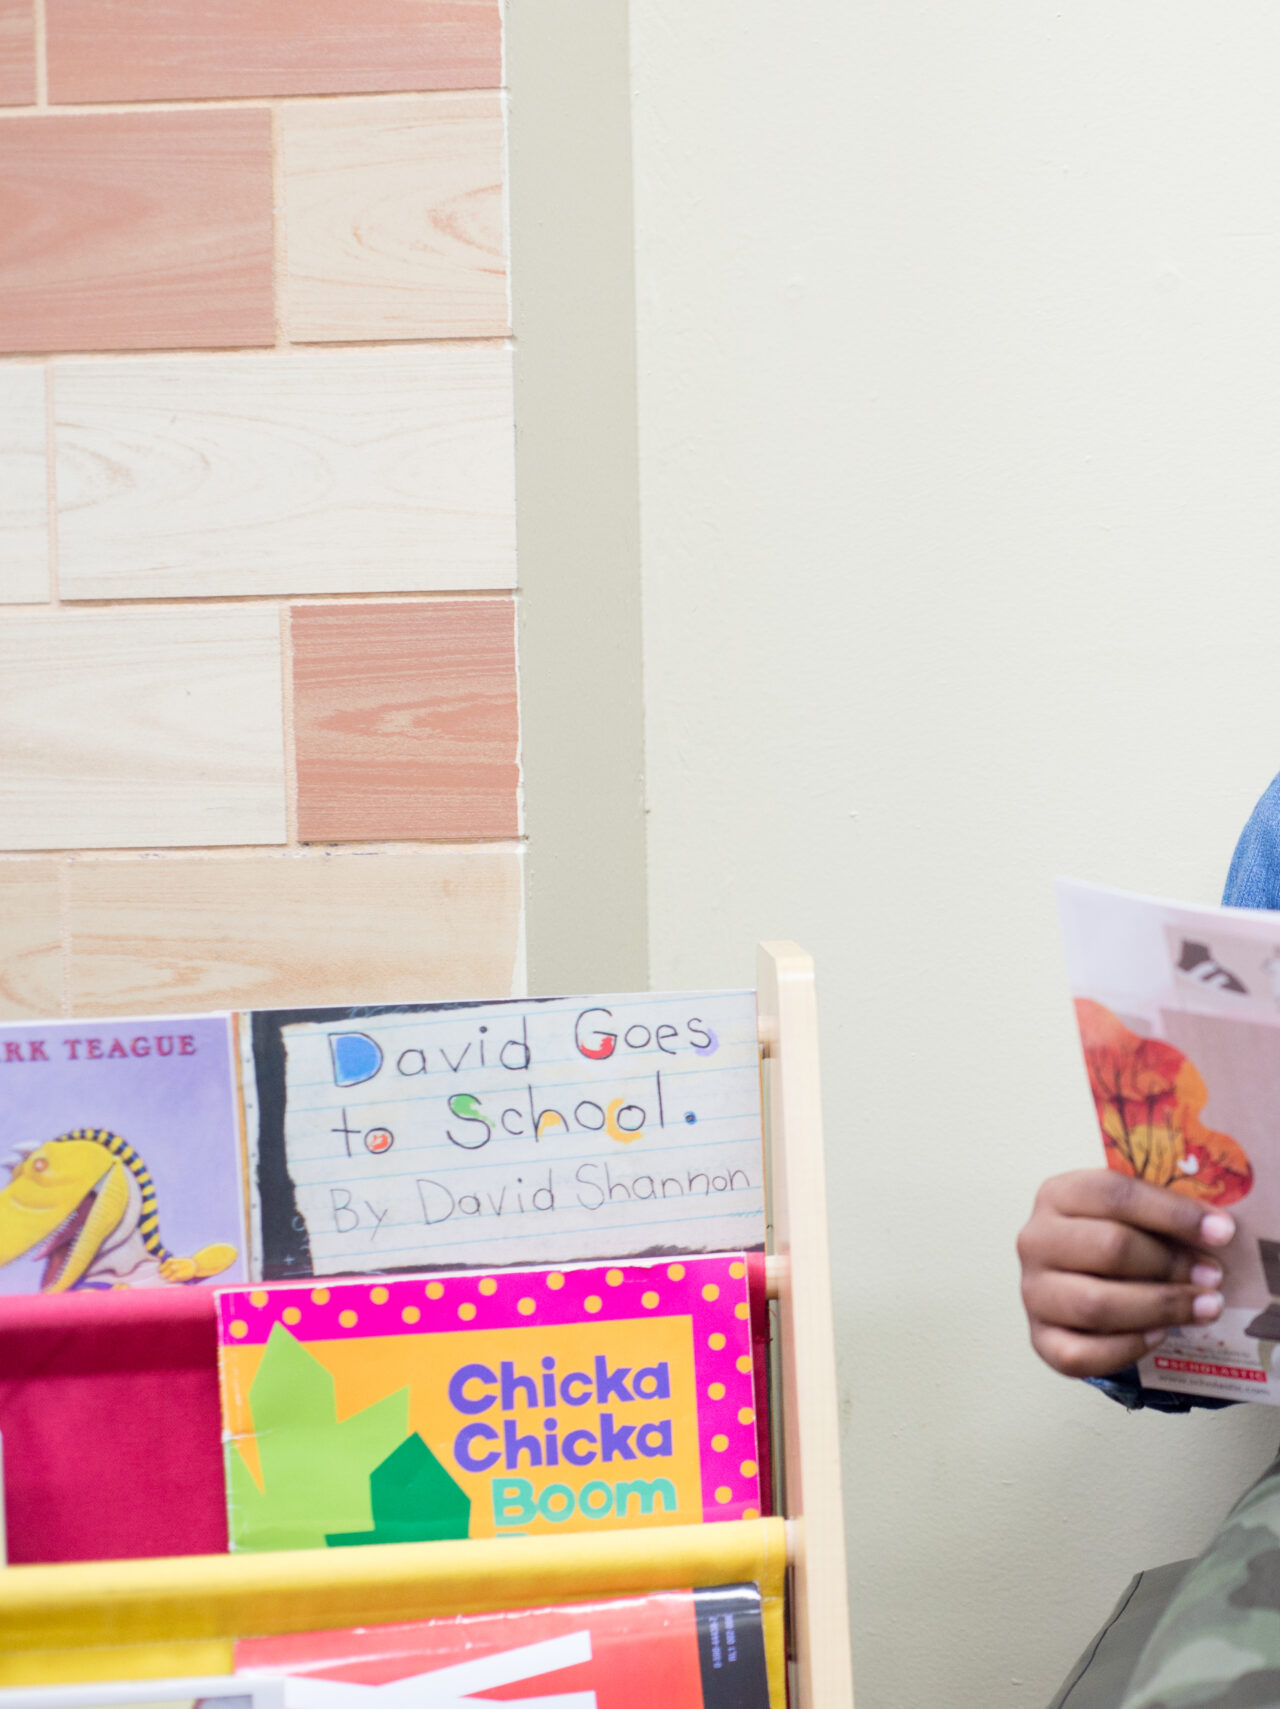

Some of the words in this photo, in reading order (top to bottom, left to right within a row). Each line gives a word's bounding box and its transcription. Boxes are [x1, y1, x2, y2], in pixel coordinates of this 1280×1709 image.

[0, 1040, 50, 1063] RK
[63, 1034, 198, 1060] TEAGUE
[327, 1015, 532, 1088] David
[574, 1007, 713, 1061] Goes
[331, 1107, 395, 1158] to
[446, 1070, 697, 1150] School.
[330, 1187, 389, 1241] By
[416, 1167, 556, 1226] David
[575, 1160, 751, 1212] Shannon
[447, 1354, 671, 1416] Chicka
[1170, 1360, 1263, 1382] SCHOLASTIC
[453, 1412, 674, 1473] Chicka
[490, 1477, 678, 1528] Boom
